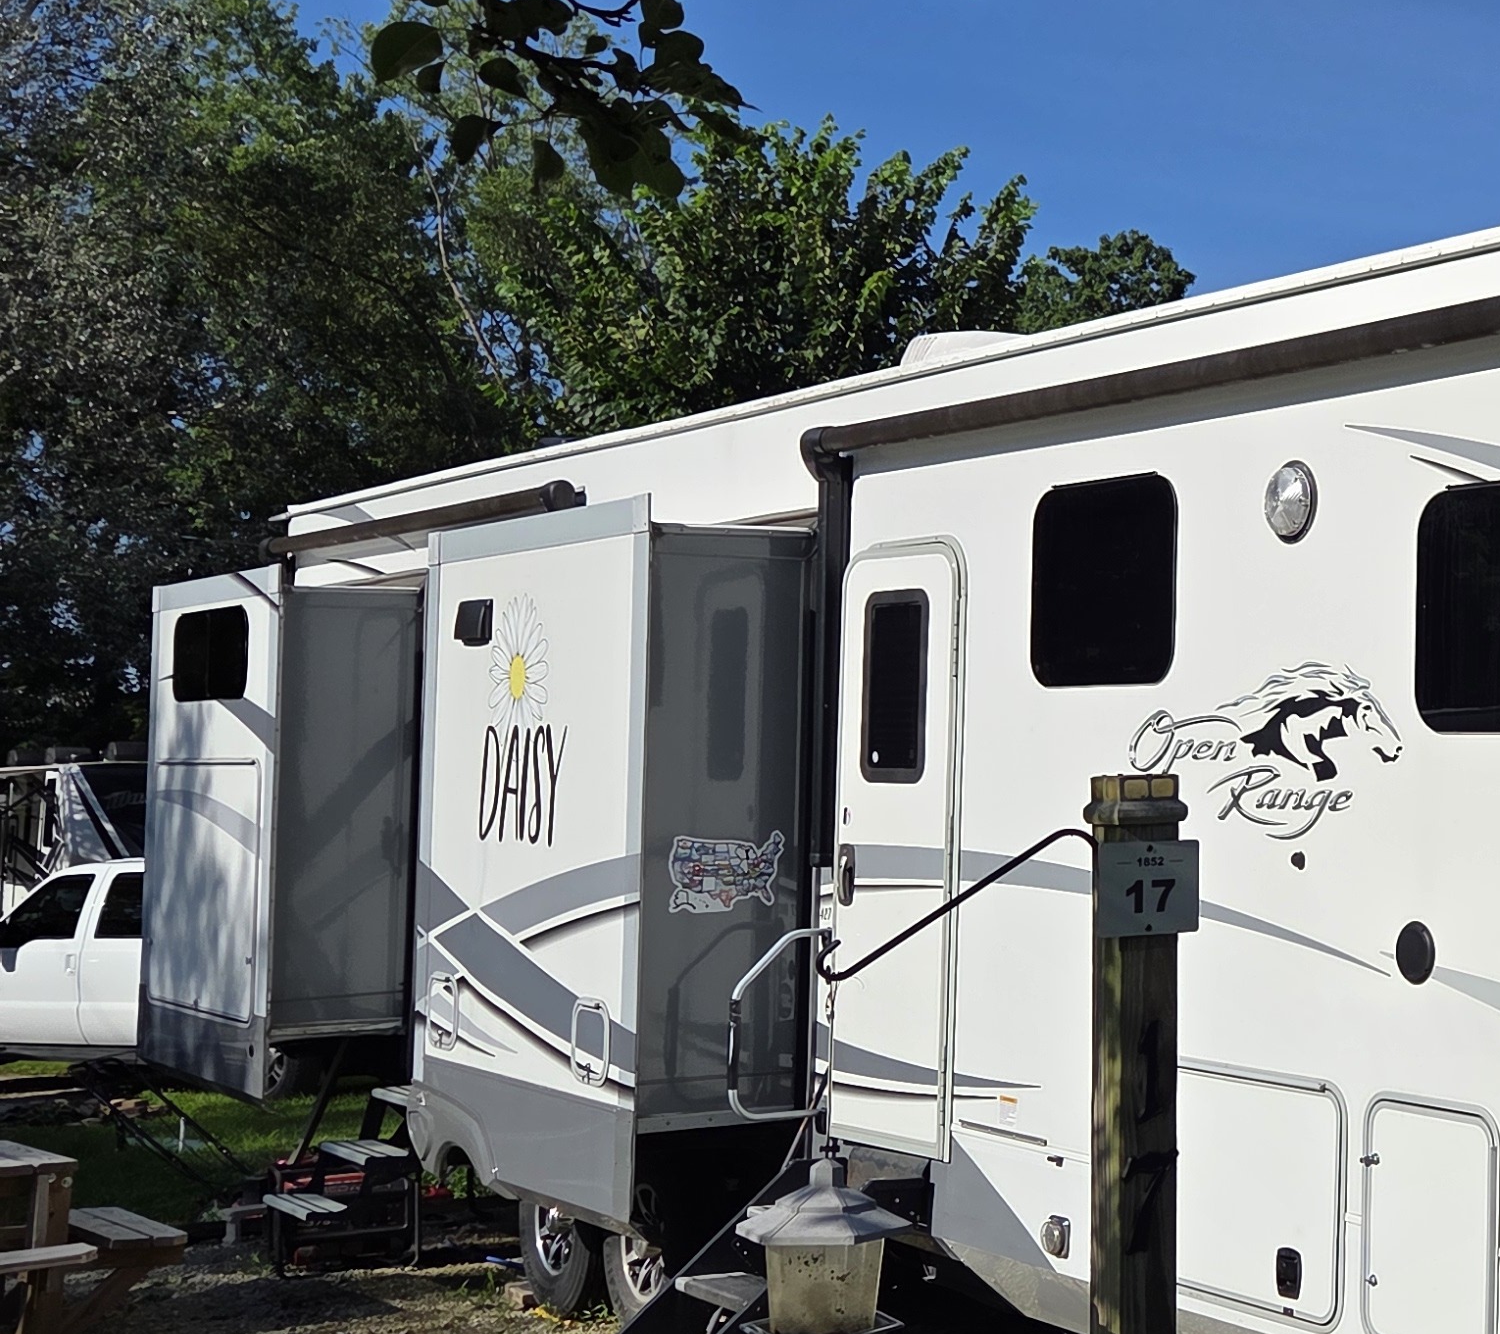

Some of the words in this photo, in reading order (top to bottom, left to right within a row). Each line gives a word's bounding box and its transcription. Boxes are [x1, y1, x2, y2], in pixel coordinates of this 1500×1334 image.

[1128, 709, 1243, 775] Open
[479, 723, 568, 848] DAISY
[1206, 764, 1354, 840] Range
[1136, 856, 1165, 867] 1852
[1125, 878, 1176, 914] 17
